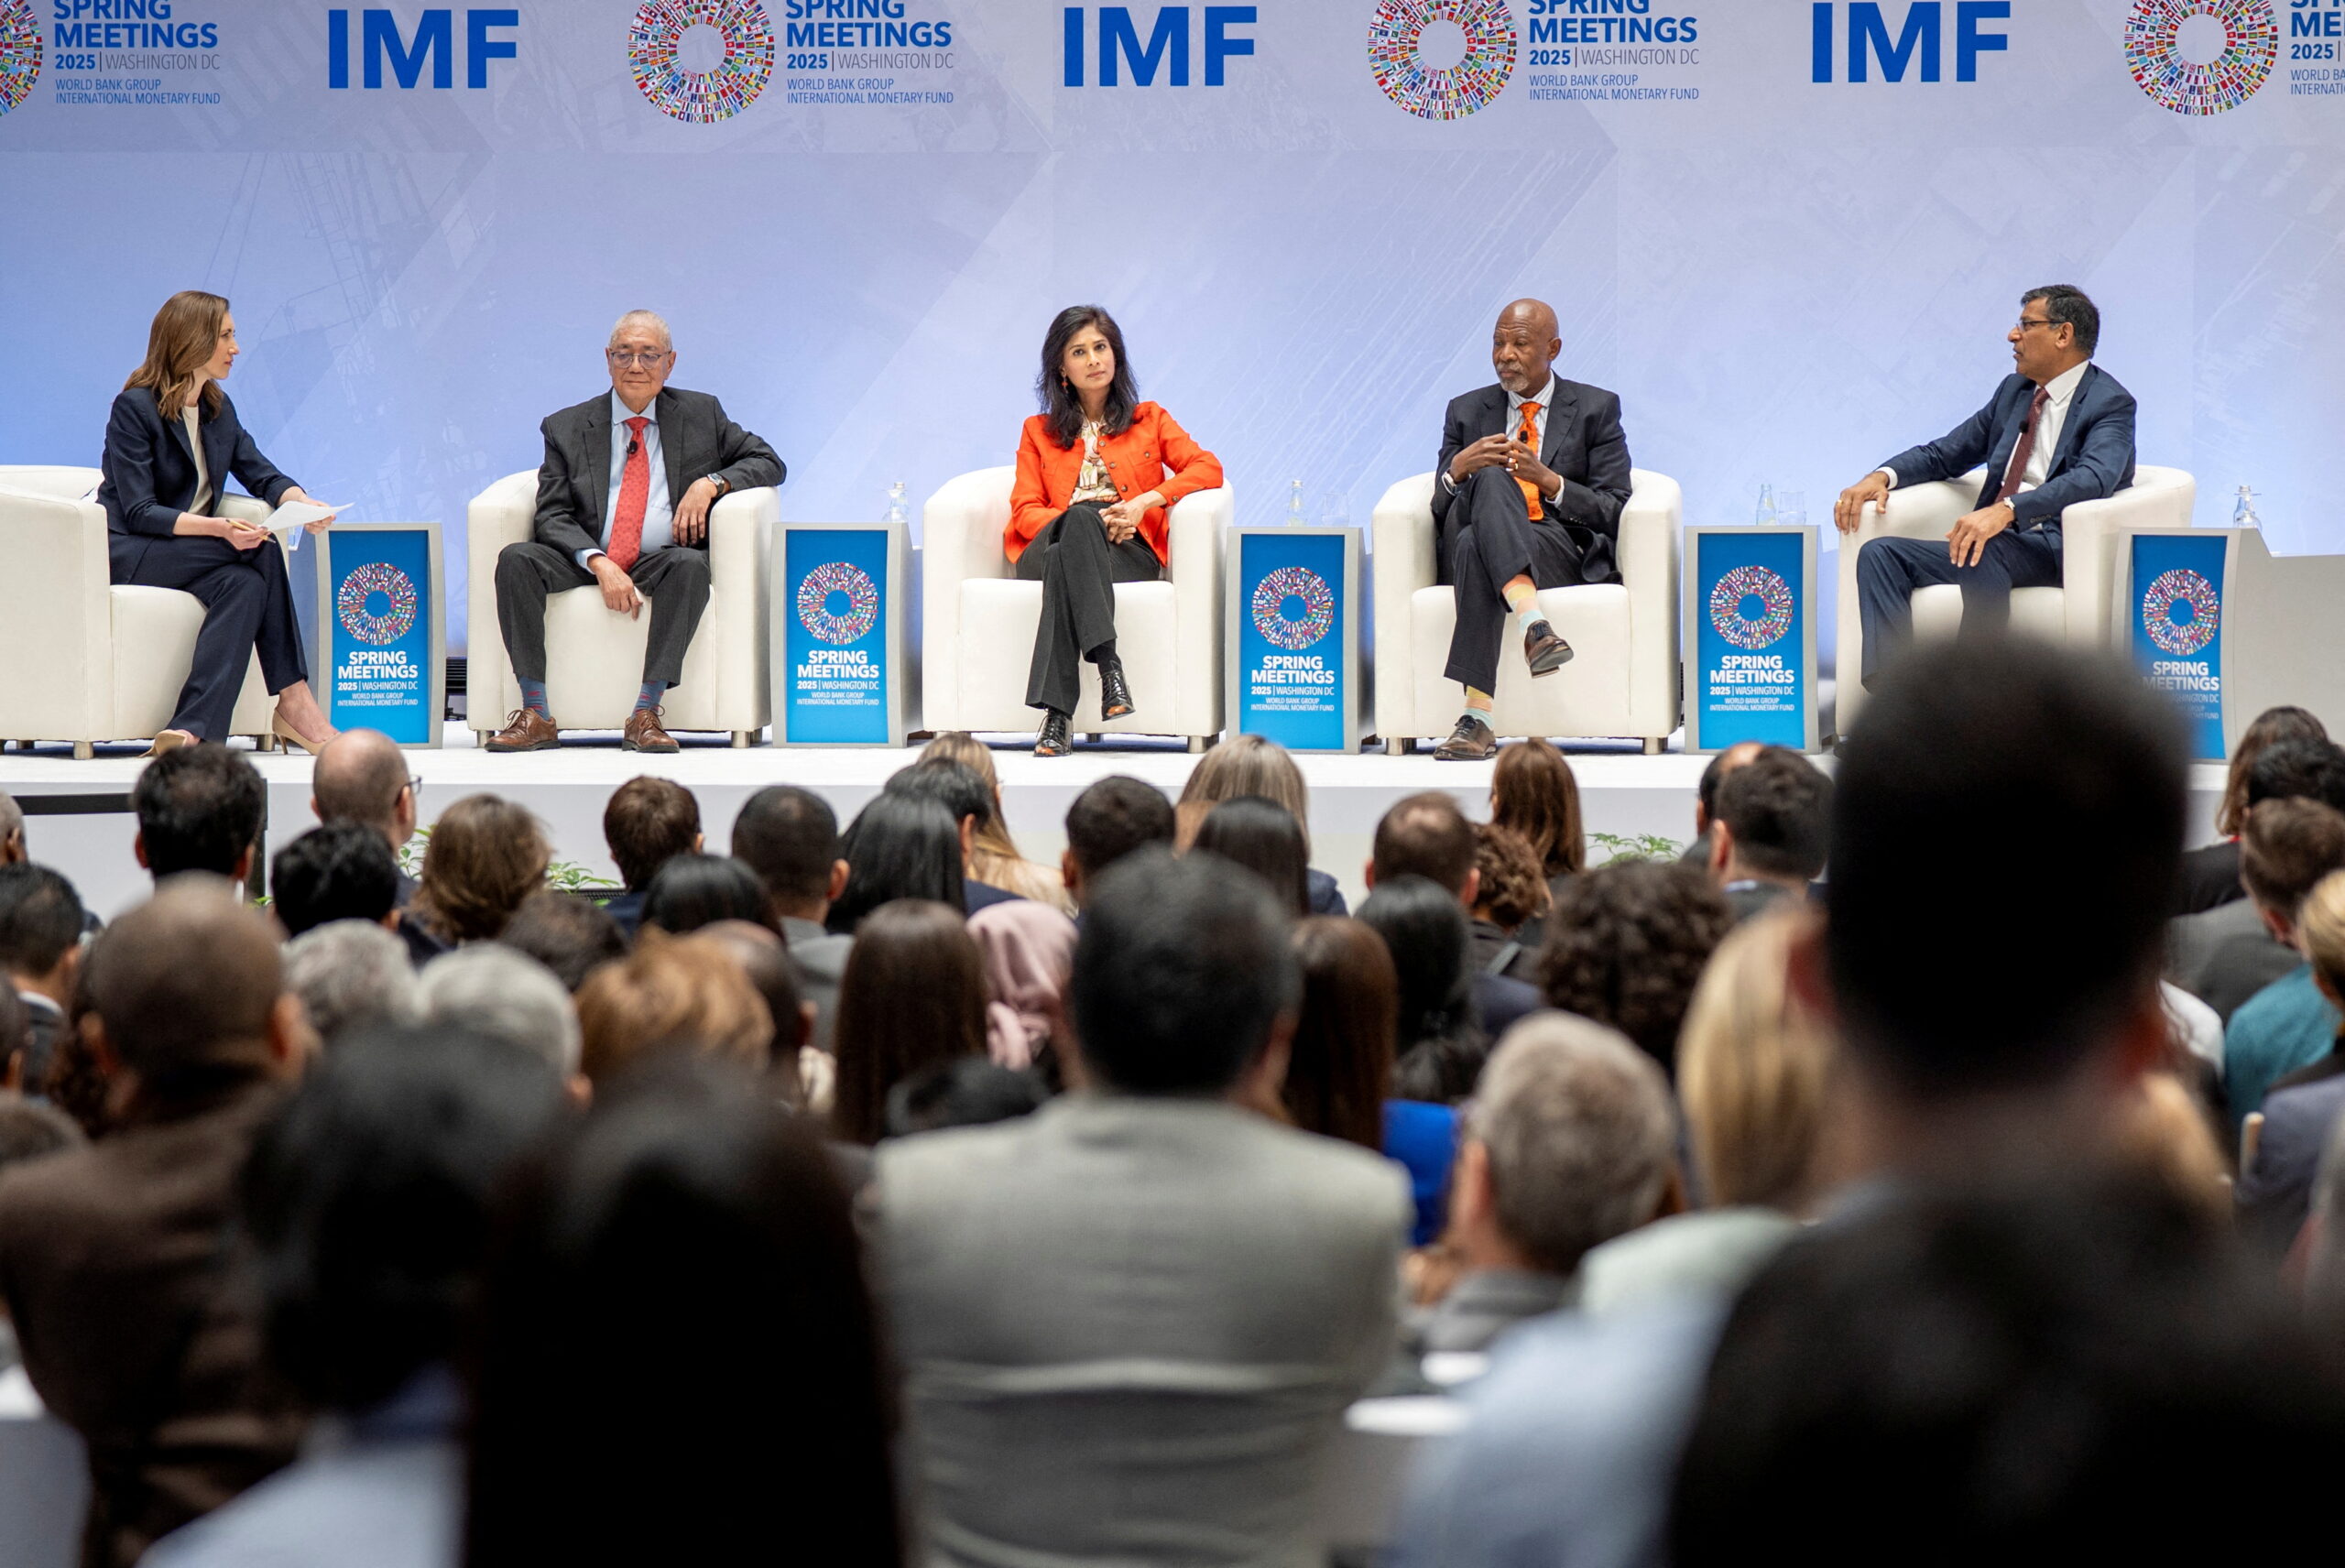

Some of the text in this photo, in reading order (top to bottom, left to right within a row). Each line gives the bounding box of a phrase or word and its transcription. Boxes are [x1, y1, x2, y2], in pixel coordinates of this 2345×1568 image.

[54, 0, 171, 19] SPRING
[786, 0, 905, 19] SPRING
[1530, 16, 1697, 43] MEETINGS
[2292, 12, 2345, 38] ME
[55, 23, 218, 49] MEETINGS
[787, 22, 952, 48] MEETINGS
[1813, 1, 2011, 82] IMF
[329, 9, 518, 89] IMF
[1064, 6, 1257, 87] IMF
[2291, 44, 2334, 60] 2025
[55, 54, 221, 70] 2025 WASHINGTON DC
[787, 53, 954, 70] 2025 WASHINGTON DC
[1530, 49, 1699, 65] 2025 WASHINGTON DC
[1530, 75, 1639, 86] WORLD BANK GROUP
[2291, 70, 2329, 82] WORLD
[56, 79, 161, 91] WORLD BANK GROUP
[788, 79, 894, 90] WORLD BANK GROUP
[2291, 83, 2345, 95] INTERNATI
[56, 93, 221, 104] INTERNATIONAL MONETARY FUND
[788, 93, 954, 103] INTERNATIONAL MONETARY FUND
[1530, 89, 1699, 100] INTERNATIONAL MONETARY FUND
[349, 651, 407, 665] SPRING
[809, 650, 867, 664] SPRING
[1263, 656, 1323, 670] SPRING
[1722, 656, 1783, 670] SPRING
[338, 665, 419, 680] MEETINGS
[798, 665, 879, 678] MEETINGS
[2153, 661, 2209, 676] SPRING
[1251, 670, 1335, 684] MEETINGS
[1710, 670, 1794, 683] MEETINGS
[338, 681, 418, 691] 2025 WASHINGTON DC
[797, 681, 879, 690] 2025 WASHINGTON DC
[1251, 686, 1335, 695] 2025 WASHINGTON DC
[1710, 686, 1794, 695] 2025 WASHINGTON DC
[2143, 677, 2220, 691] MEETINGS
[2209, 693, 2219, 703] DC
